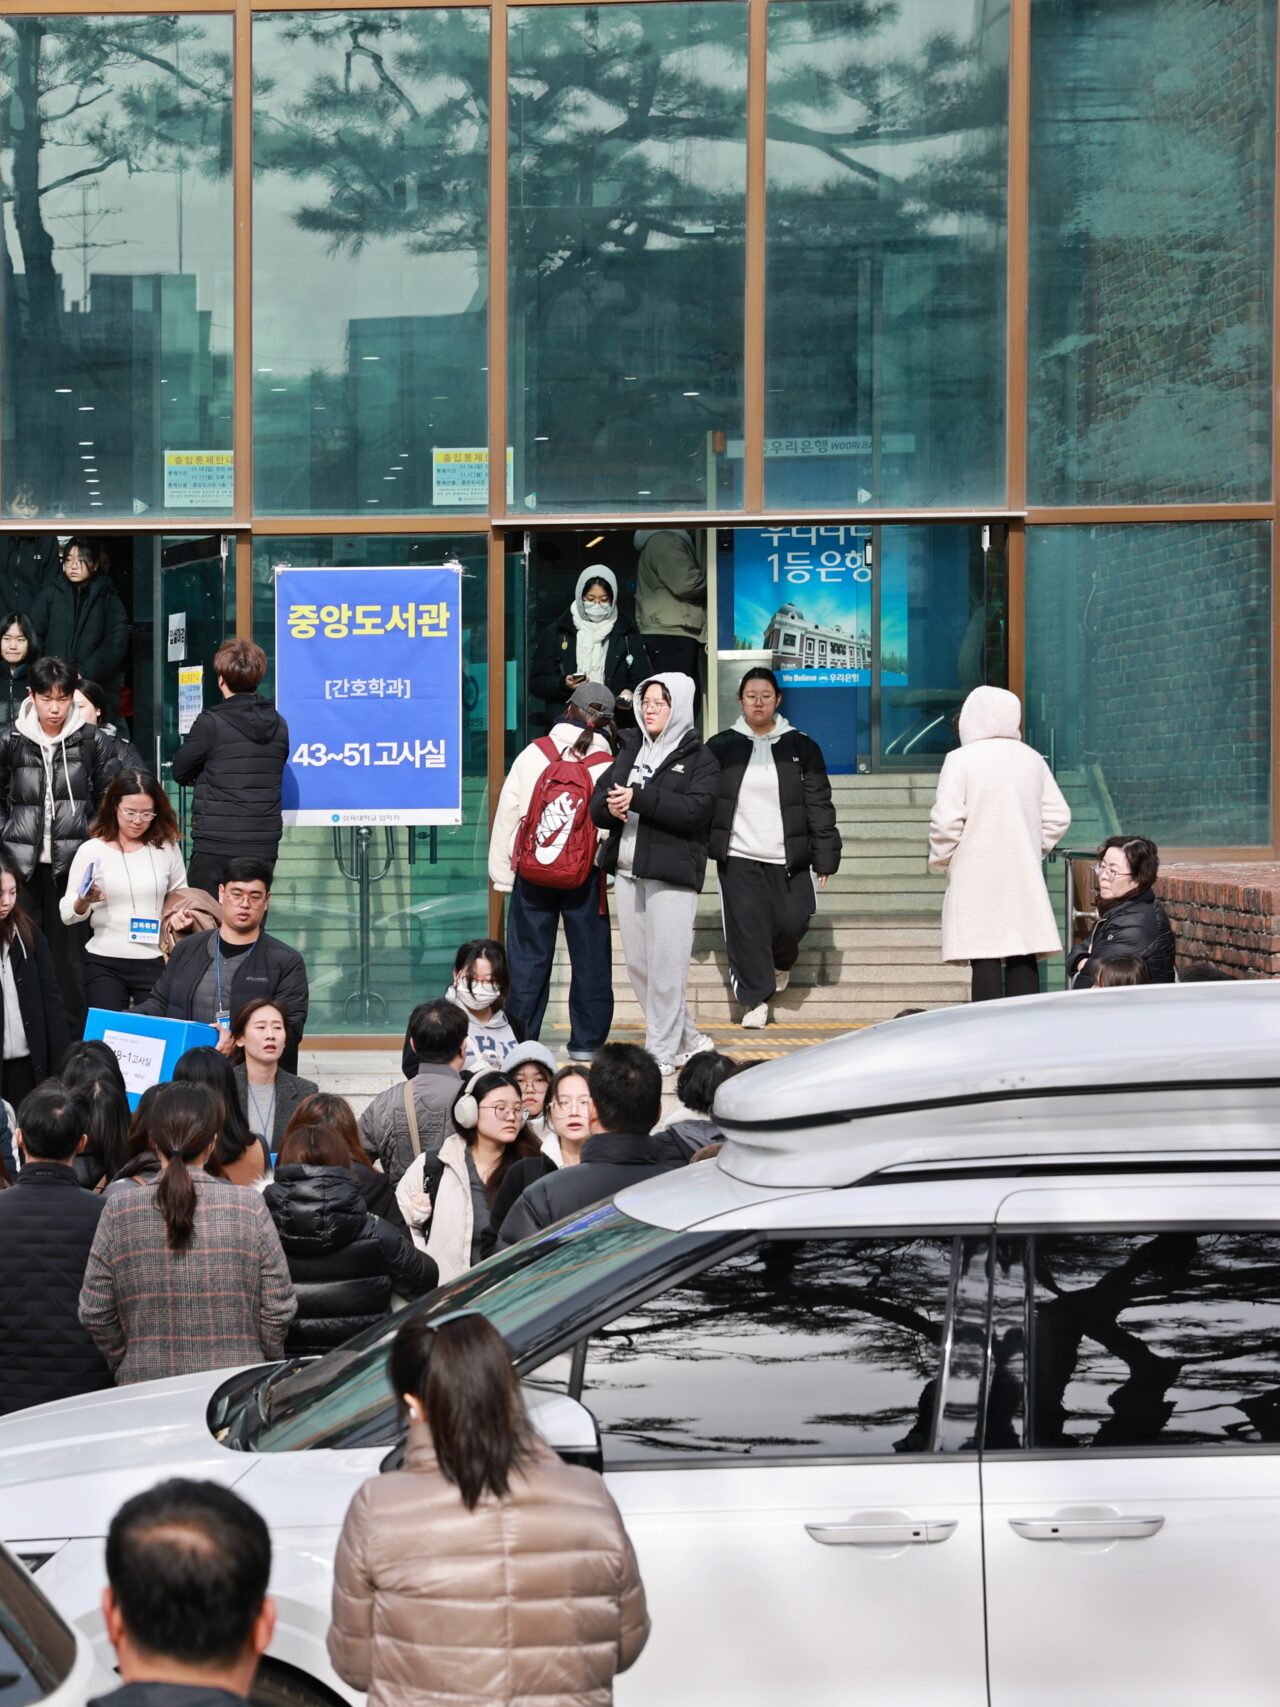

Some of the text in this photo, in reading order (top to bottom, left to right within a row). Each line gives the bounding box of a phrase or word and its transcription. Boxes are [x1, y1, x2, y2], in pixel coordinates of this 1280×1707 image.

[771, 440, 829, 454] 우리은행
[831, 440, 887, 450] WOORI BAK
[443, 453, 488, 463] 출입통제
[767, 550, 873, 584] 1등은행
[287, 602, 451, 639] 중앙도서관
[830, 673, 859, 683] 우리은행
[325, 678, 411, 699] [간호학과]
[113, 1049, 152, 1067] 8-1고사실
